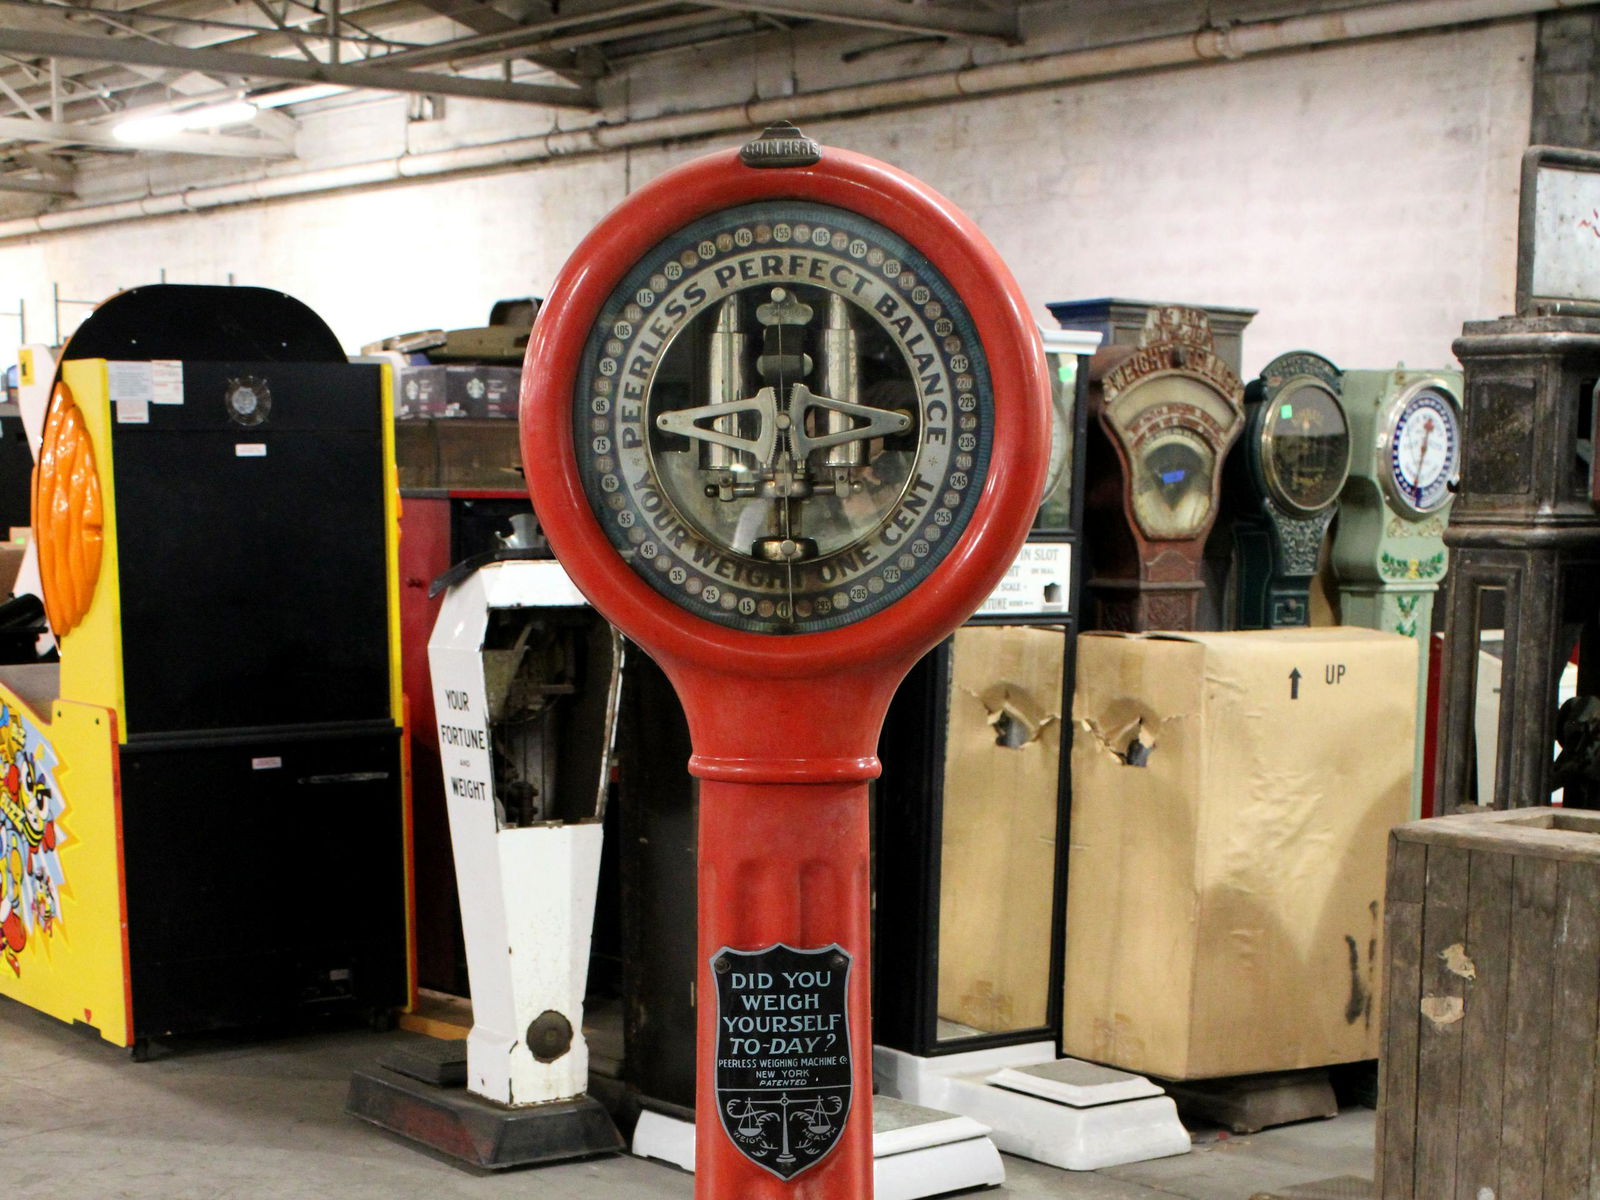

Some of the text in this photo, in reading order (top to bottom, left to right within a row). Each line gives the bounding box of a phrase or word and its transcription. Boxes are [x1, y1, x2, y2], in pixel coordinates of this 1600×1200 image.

[742, 140, 821, 157] COIN HERE
[621, 254, 948, 449] PEERLESS PERFECT BALANCE
[633, 470, 935, 591] YOUR WEIGHT ONE CENT
[1034, 548, 1059, 561] SLOT
[1325, 664, 1346, 685] UP
[445, 689, 470, 712] YOUR
[441, 724, 486, 750] FORTUNE
[451, 778, 486, 801] WEIGHT
[731, 971, 831, 989] DID YOU
[741, 994, 819, 1011] WEIGH
[723, 1014, 841, 1033] YOURSELF
[718, 1059, 757, 1069] PEERLESS
[759, 1058, 798, 1068] WEIGHING
[800, 1056, 837, 1067] MACHINE
[756, 1069, 810, 1079] NEW YORK
[759, 1078, 808, 1087] PATENTED
[733, 1127, 838, 1144] WEIGHT HEALTH
